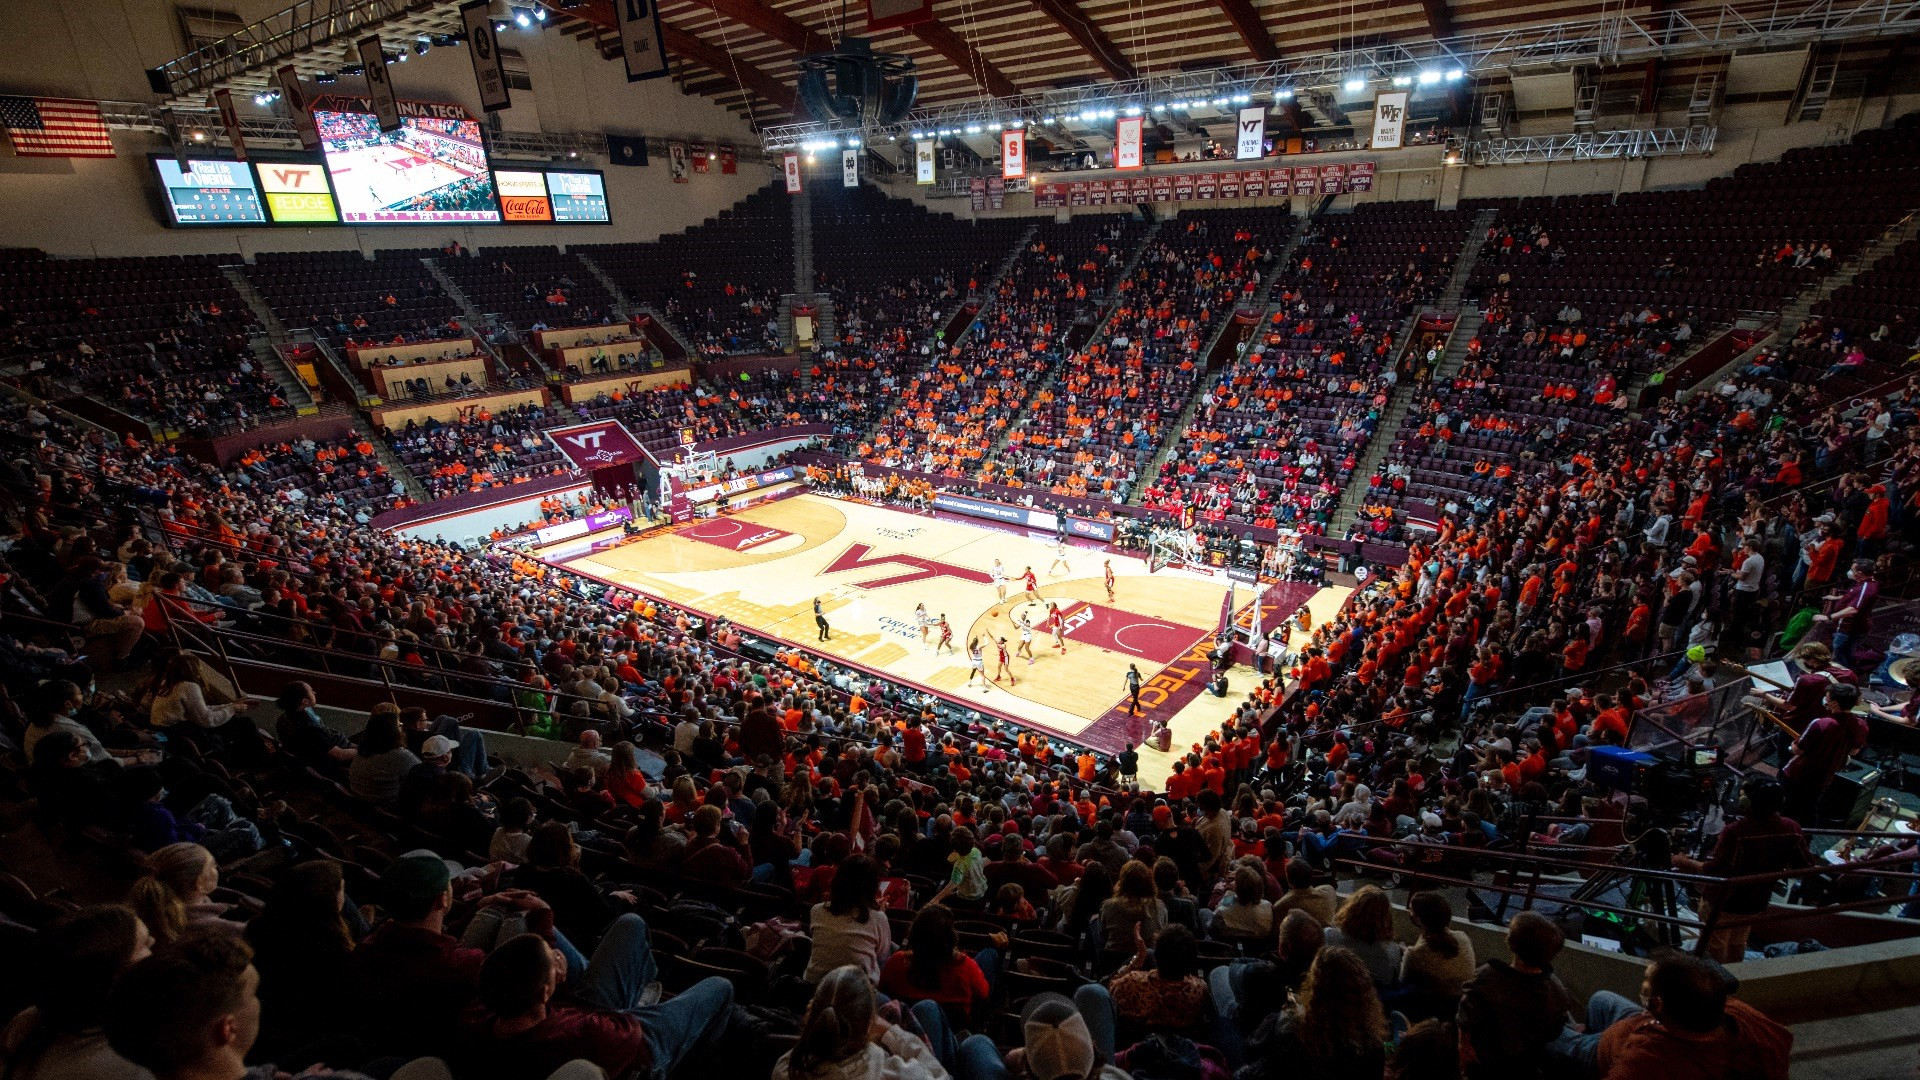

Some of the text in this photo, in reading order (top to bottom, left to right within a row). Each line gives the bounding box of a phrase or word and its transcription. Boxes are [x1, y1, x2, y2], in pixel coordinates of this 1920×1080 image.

[430, 105, 464, 118] TECH
[1242, 120, 1261, 132] VT
[1009, 141, 1018, 156] S
[200, 163, 231, 174] Real Life
[273, 169, 310, 187] VT
[1270, 181, 1288, 189] NCAA
[283, 196, 329, 210] EDGE
[565, 430, 606, 449] VT
[981, 506, 1000, 515] Lending
[737, 530, 781, 549] ACC
[1064, 606, 1094, 636] ACC
[1115, 667, 1201, 718] TECH
